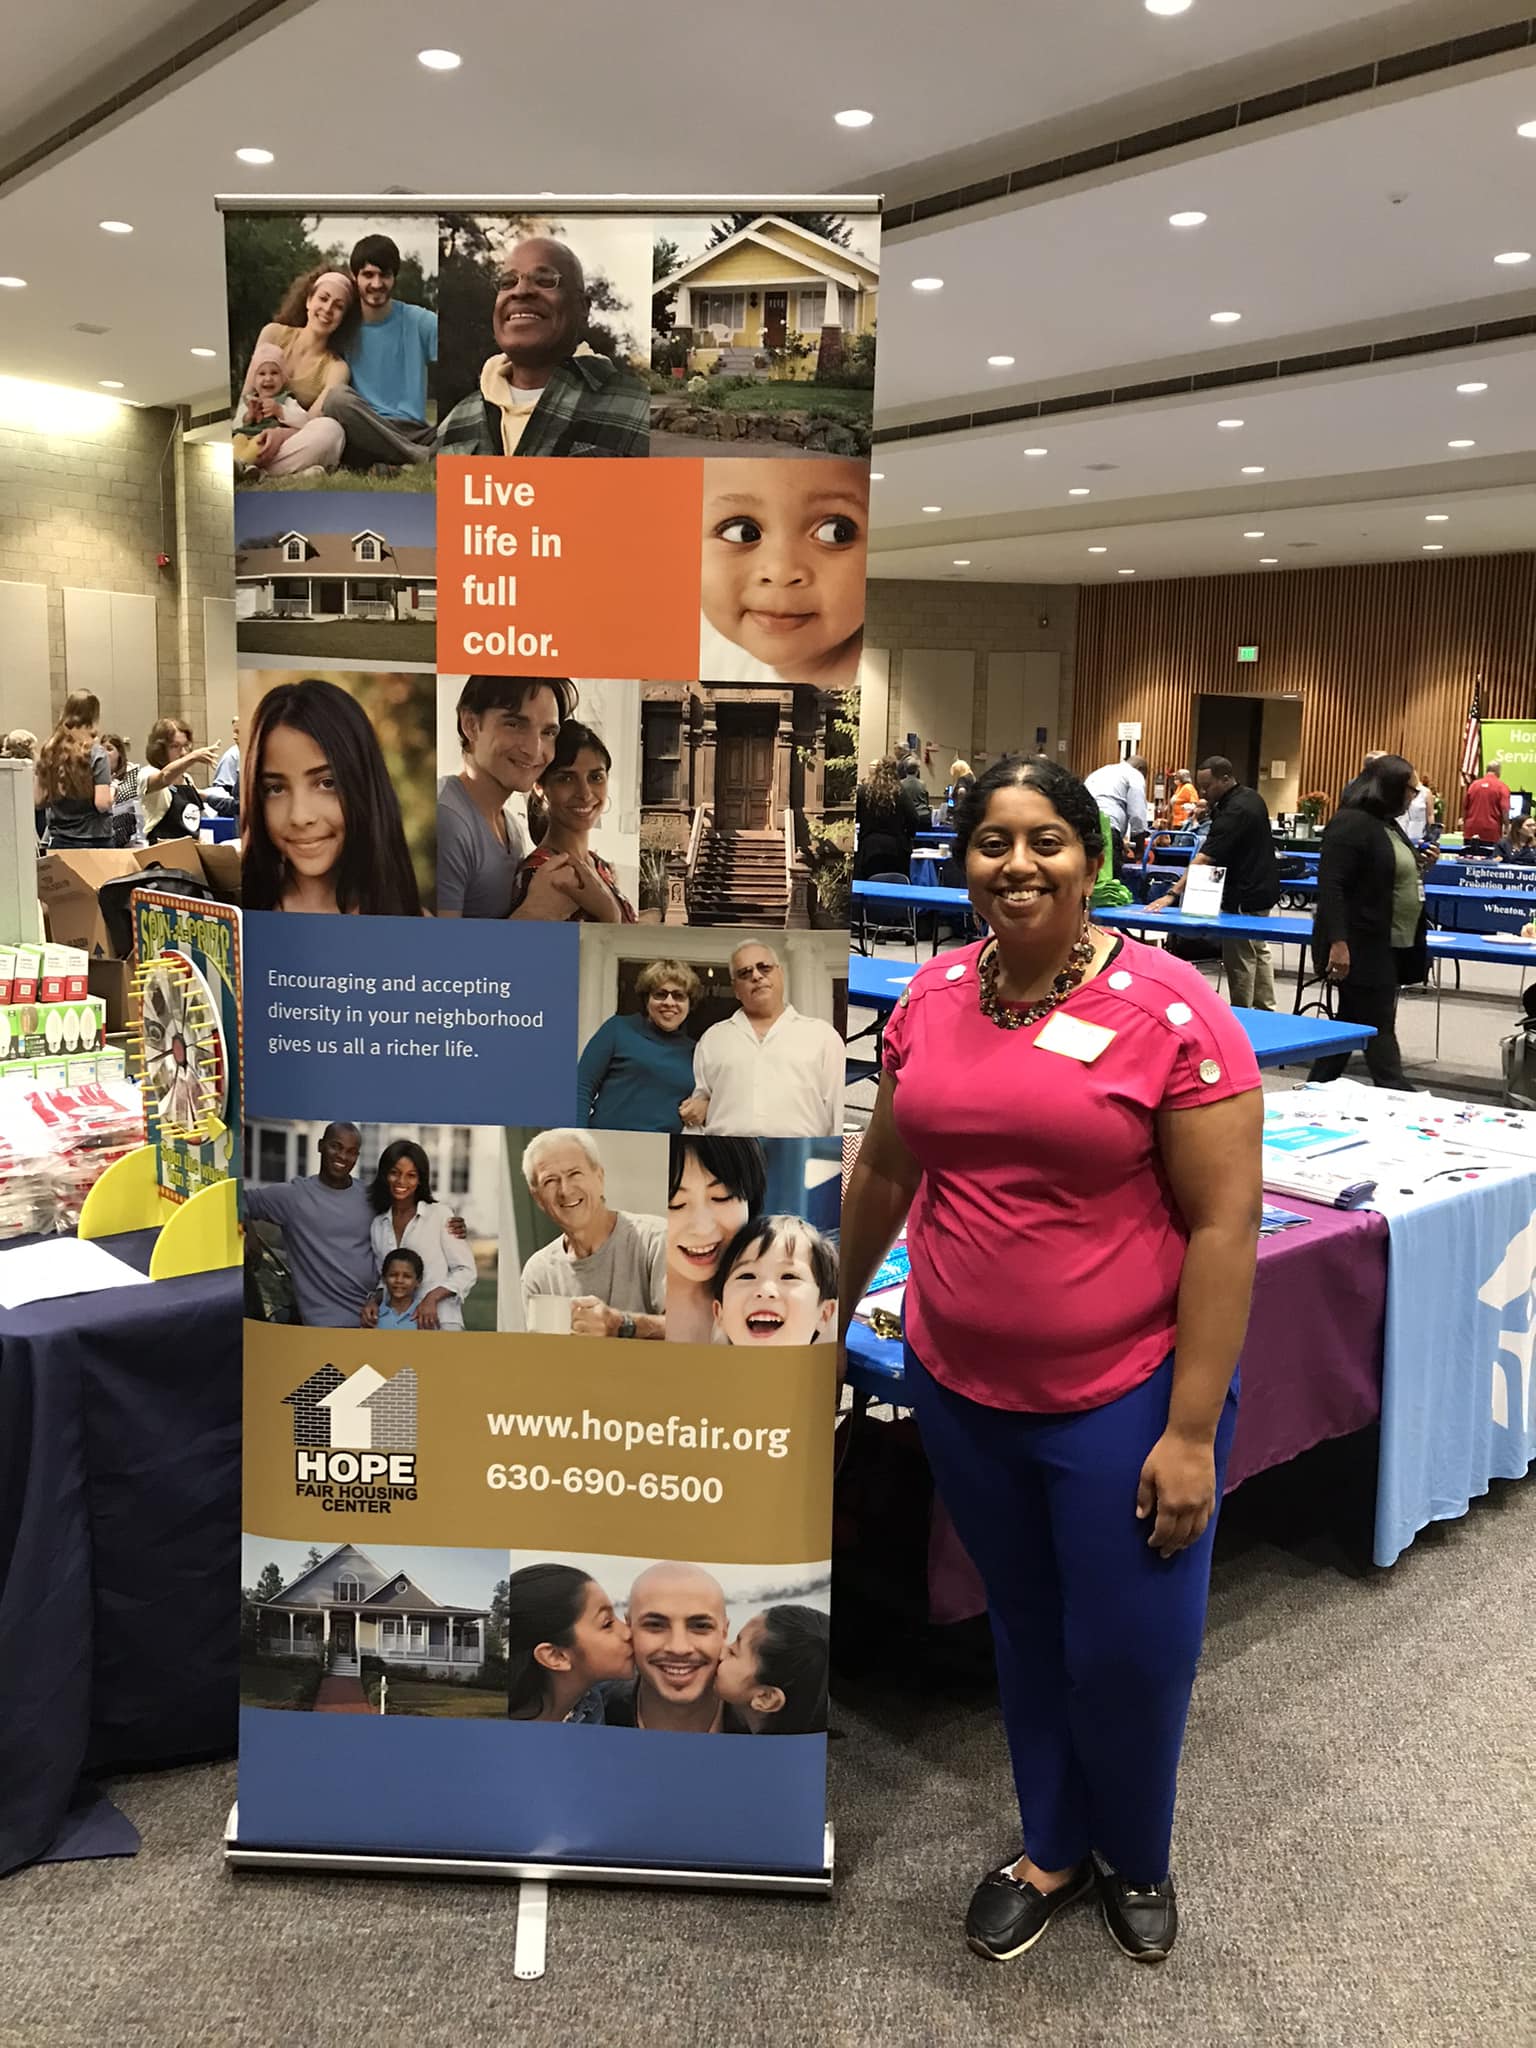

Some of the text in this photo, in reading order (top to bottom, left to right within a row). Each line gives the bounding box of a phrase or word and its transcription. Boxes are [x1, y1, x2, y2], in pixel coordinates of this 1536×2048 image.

[464, 474, 535, 507] Live
[464, 524, 562, 558] life in
[462, 574, 517, 606] full
[463, 625, 559, 657] color.
[1496, 749, 1536, 763] Servi
[1459, 878, 1503, 890] Probation
[1505, 882, 1523, 892] and
[1466, 866, 1515, 880] Eighteenth
[1483, 903, 1527, 917] Wheaton,
[268, 969, 512, 999] Encouraging and accepting
[268, 1002, 544, 1029] diversity in your neighborhood
[268, 1034, 479, 1058] gives us all a richer life.
[487, 1409, 791, 1458] www.hopefair.org
[296, 1449, 417, 1486] HOPE
[296, 1483, 418, 1500] FAIR HOUSING
[486, 1463, 724, 1503] 630-690-6500
[322, 1499, 391, 1513] CENTER
